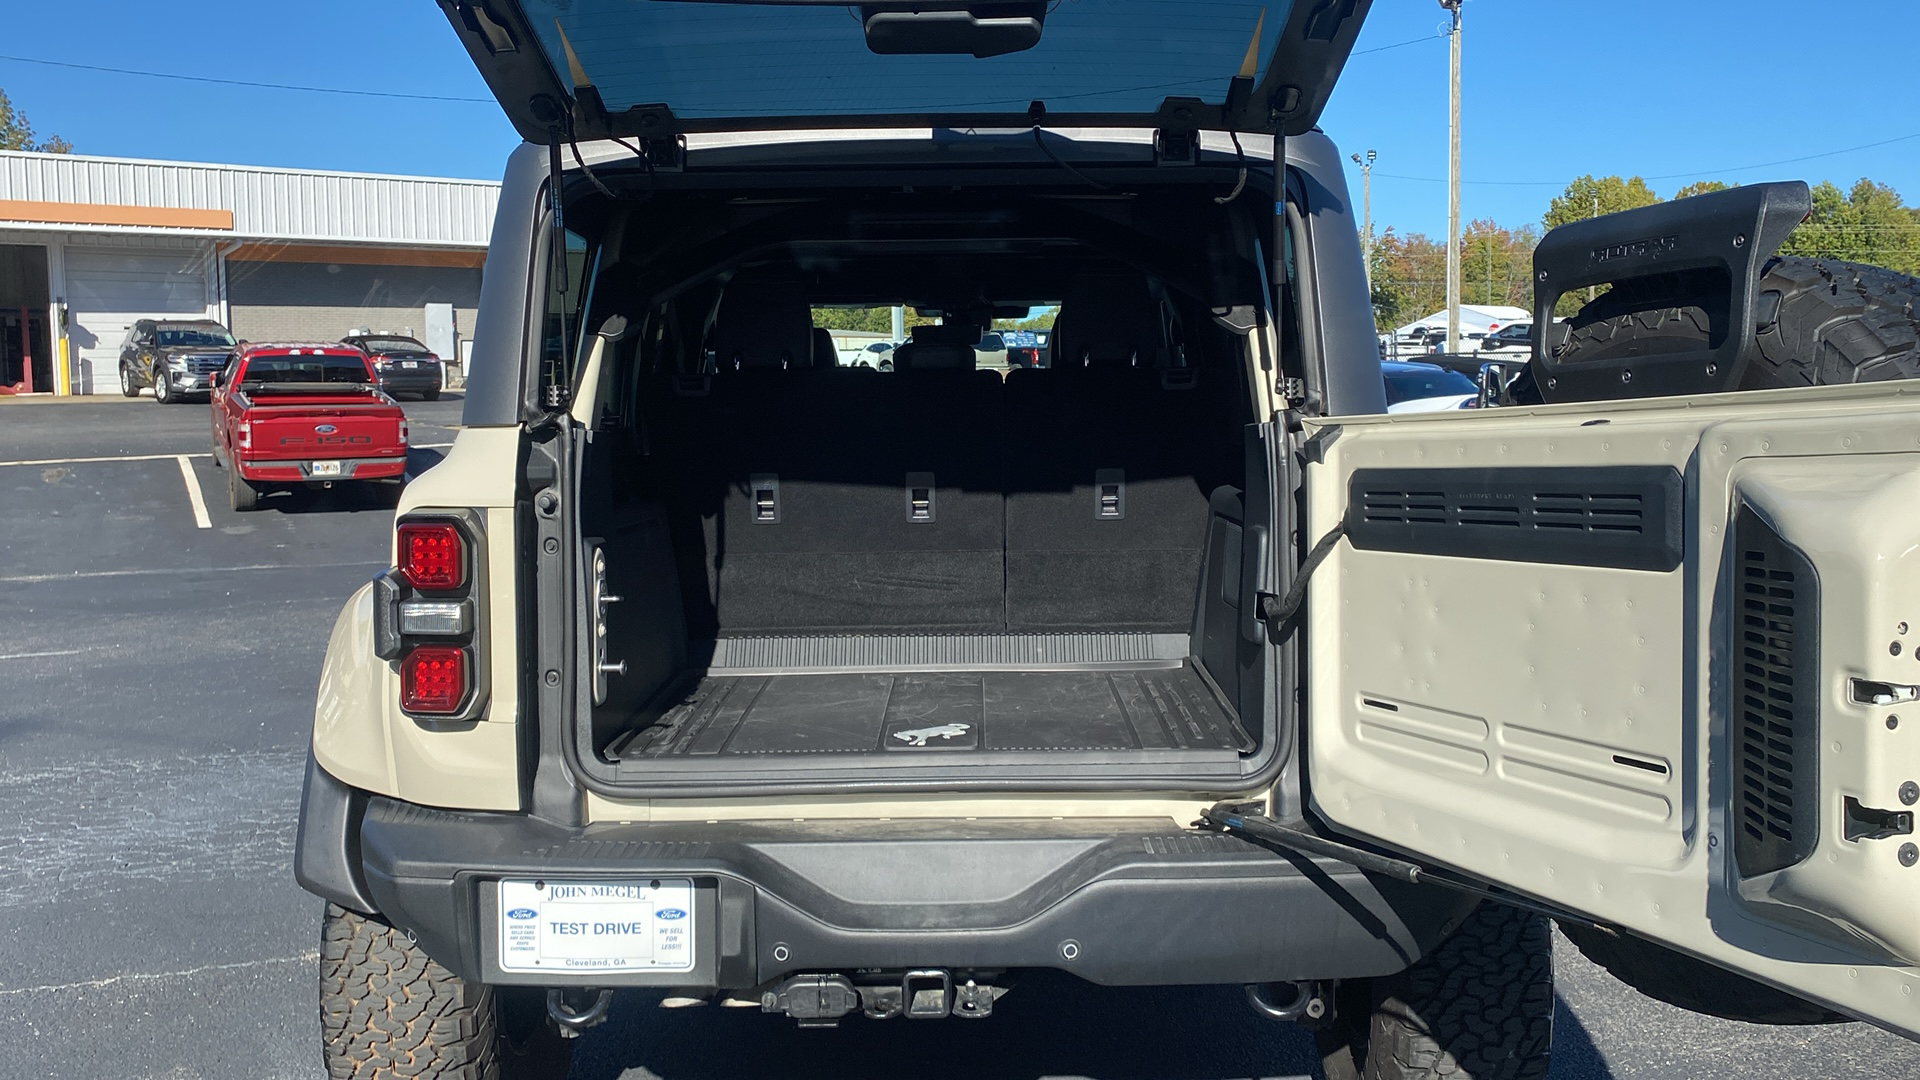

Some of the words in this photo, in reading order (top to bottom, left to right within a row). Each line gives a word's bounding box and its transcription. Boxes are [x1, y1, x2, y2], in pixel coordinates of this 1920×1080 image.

[280, 436, 371, 445] F-150
[547, 885, 587, 902] JOHN
[590, 885, 647, 901] MEGEL
[511, 909, 534, 920] Ford
[659, 909, 683, 920] Ford
[549, 921, 589, 935] TEST
[593, 921, 642, 935] DRIVE
[659, 927, 669, 935] WE
[669, 927, 684, 935] SELL
[665, 935, 678, 943] FOR
[565, 958, 611, 967] Cleveland,
[613, 958, 627, 966] GA
